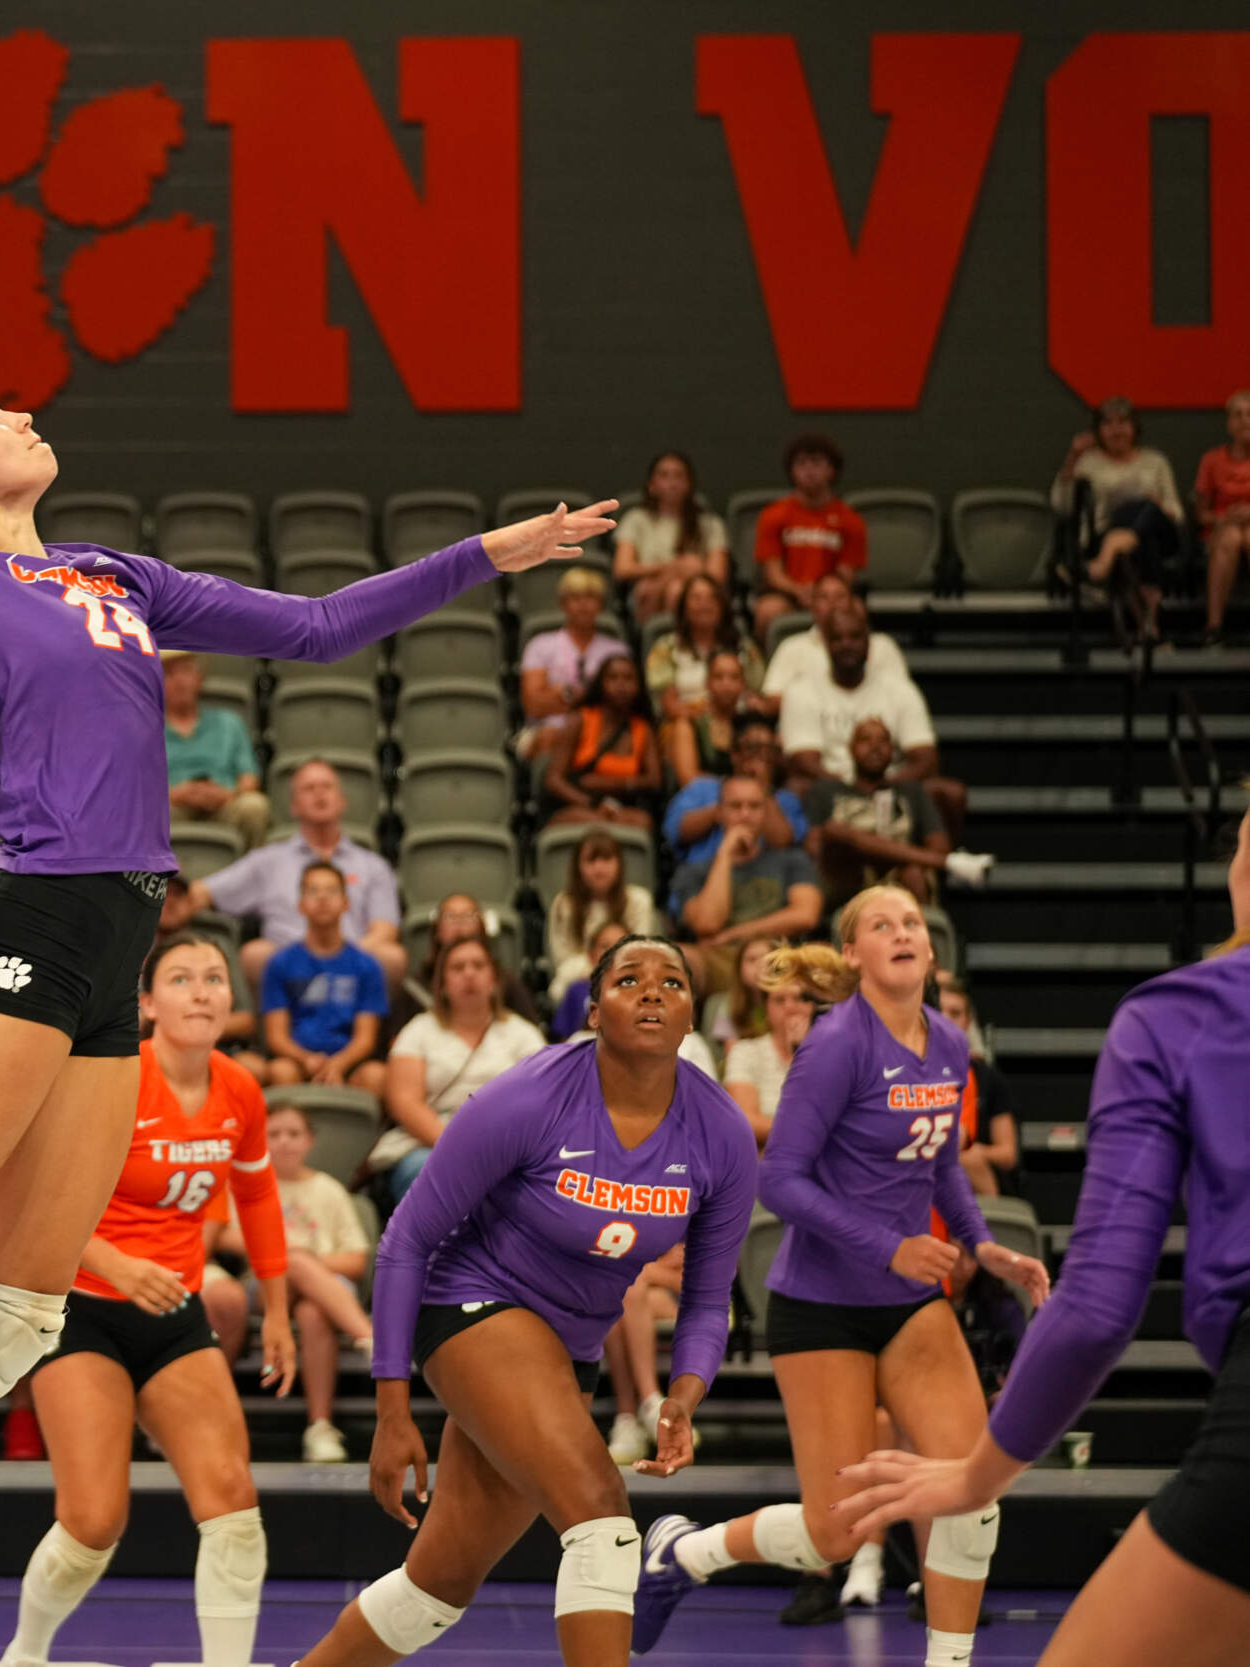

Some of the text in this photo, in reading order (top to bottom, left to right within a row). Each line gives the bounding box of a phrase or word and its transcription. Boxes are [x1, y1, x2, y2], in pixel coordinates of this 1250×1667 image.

[62, 585, 156, 657] 24
[895, 1112, 954, 1162] 25
[157, 1168, 217, 1213] 16
[555, 1168, 691, 1217] CLEMSON
[588, 1219, 639, 1260] 9
